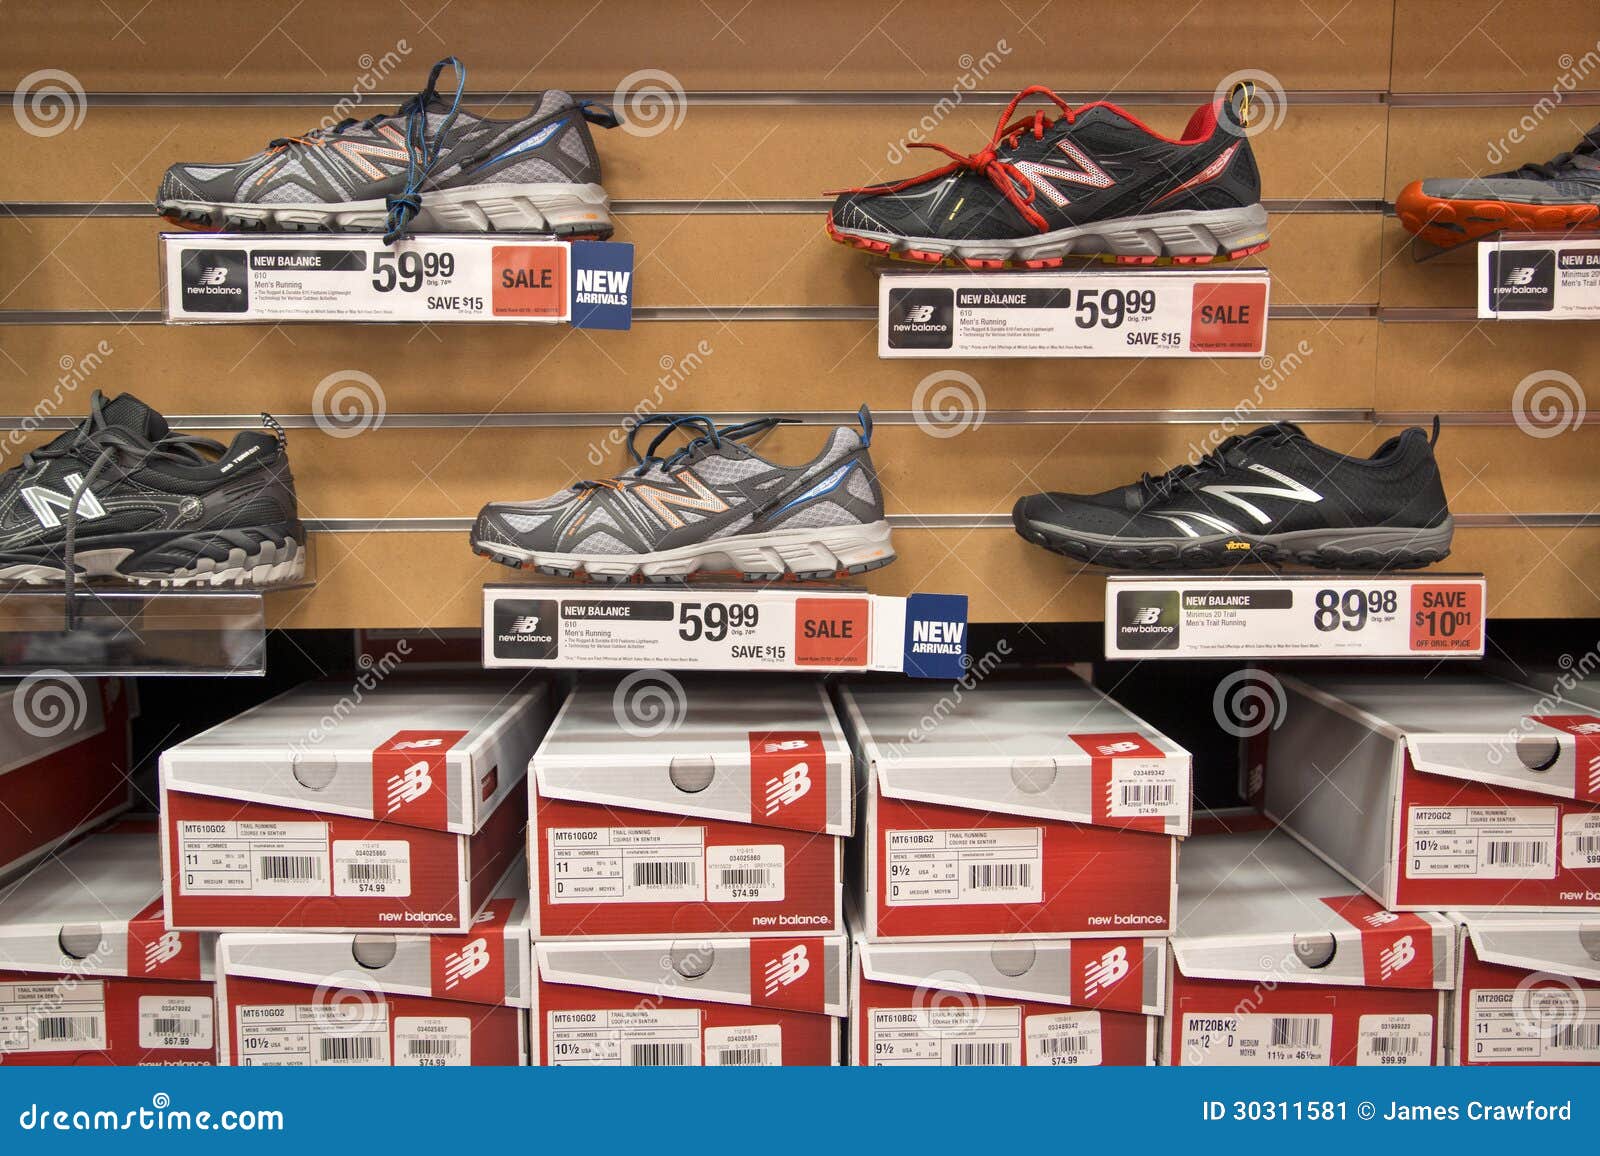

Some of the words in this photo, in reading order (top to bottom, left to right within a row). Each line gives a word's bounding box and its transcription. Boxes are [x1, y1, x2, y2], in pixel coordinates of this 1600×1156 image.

[254, 256, 277, 268] NEW
[278, 256, 321, 268] BALANCE
[1562, 256, 1583, 265] NEW
[254, 272, 267, 280] 610
[502, 269, 552, 289] SALE
[254, 281, 274, 289] Men's
[275, 281, 302, 290] Running
[576, 269, 630, 294] NEW
[187, 287, 206, 296] new
[206, 286, 242, 297] balance
[1512, 286, 1548, 294] balance
[427, 297, 460, 310] SAVE
[462, 297, 483, 310] $15
[575, 292, 628, 306] ARRIVALS
[960, 294, 982, 304] NEW
[984, 294, 1026, 304] BALANCE
[1201, 305, 1250, 325] SALE
[894, 324, 911, 332] new
[912, 323, 947, 332] balance
[981, 319, 1007, 327] Running
[1127, 332, 1159, 345] SAVE
[1161, 332, 1181, 345] $15
[1186, 596, 1207, 606] NEW
[1209, 596, 1250, 606] BALANCE
[1423, 592, 1466, 607] SAVE
[565, 606, 587, 616] NEW
[588, 606, 630, 617] BALANCE
[1186, 619, 1205, 627] Men's
[1206, 619, 1220, 627] Trail
[1221, 619, 1246, 628] Running
[565, 629, 583, 637] Men's
[586, 630, 611, 638] Running
[804, 620, 853, 638] SALE
[912, 620, 964, 643] NEW
[1139, 625, 1174, 633] balance
[498, 634, 517, 642] new
[517, 633, 552, 642] balance
[912, 643, 962, 655] ARRIVALS
[1416, 640, 1430, 648] OFF
[1431, 640, 1449, 648] ORIG.
[1450, 640, 1471, 648] PRICE
[731, 645, 763, 658] SAVE
[766, 645, 785, 658] $15
[1416, 812, 1452, 820] MT20GC2
[891, 835, 934, 844] MT610BG2
[186, 854, 198, 865] 11
[556, 862, 568, 873] 11
[1415, 860, 1420, 870] D
[187, 875, 194, 885] D
[359, 884, 385, 892] $74.99
[557, 882, 564, 893] D
[893, 885, 899, 896] D
[732, 889, 759, 898] $74.99
[1560, 891, 1584, 901] new
[379, 913, 402, 921] new
[405, 911, 454, 921] balance
[752, 916, 777, 925] new
[779, 914, 828, 925] balance
[1088, 916, 1112, 925] new
[1114, 914, 1163, 925] balance
[1477, 995, 1513, 1003] MT20GC2
[1189, 1020, 1237, 1032] MT20BK2
[1477, 1023, 1488, 1033] 11
[164, 1037, 190, 1046] $67.99
[1200, 1035, 1210, 1048] 12
[1228, 1035, 1233, 1047] D
[1477, 1043, 1483, 1053] D
[1051, 1056, 1078, 1066] $74.99
[1381, 1056, 1407, 1064] $99.99
